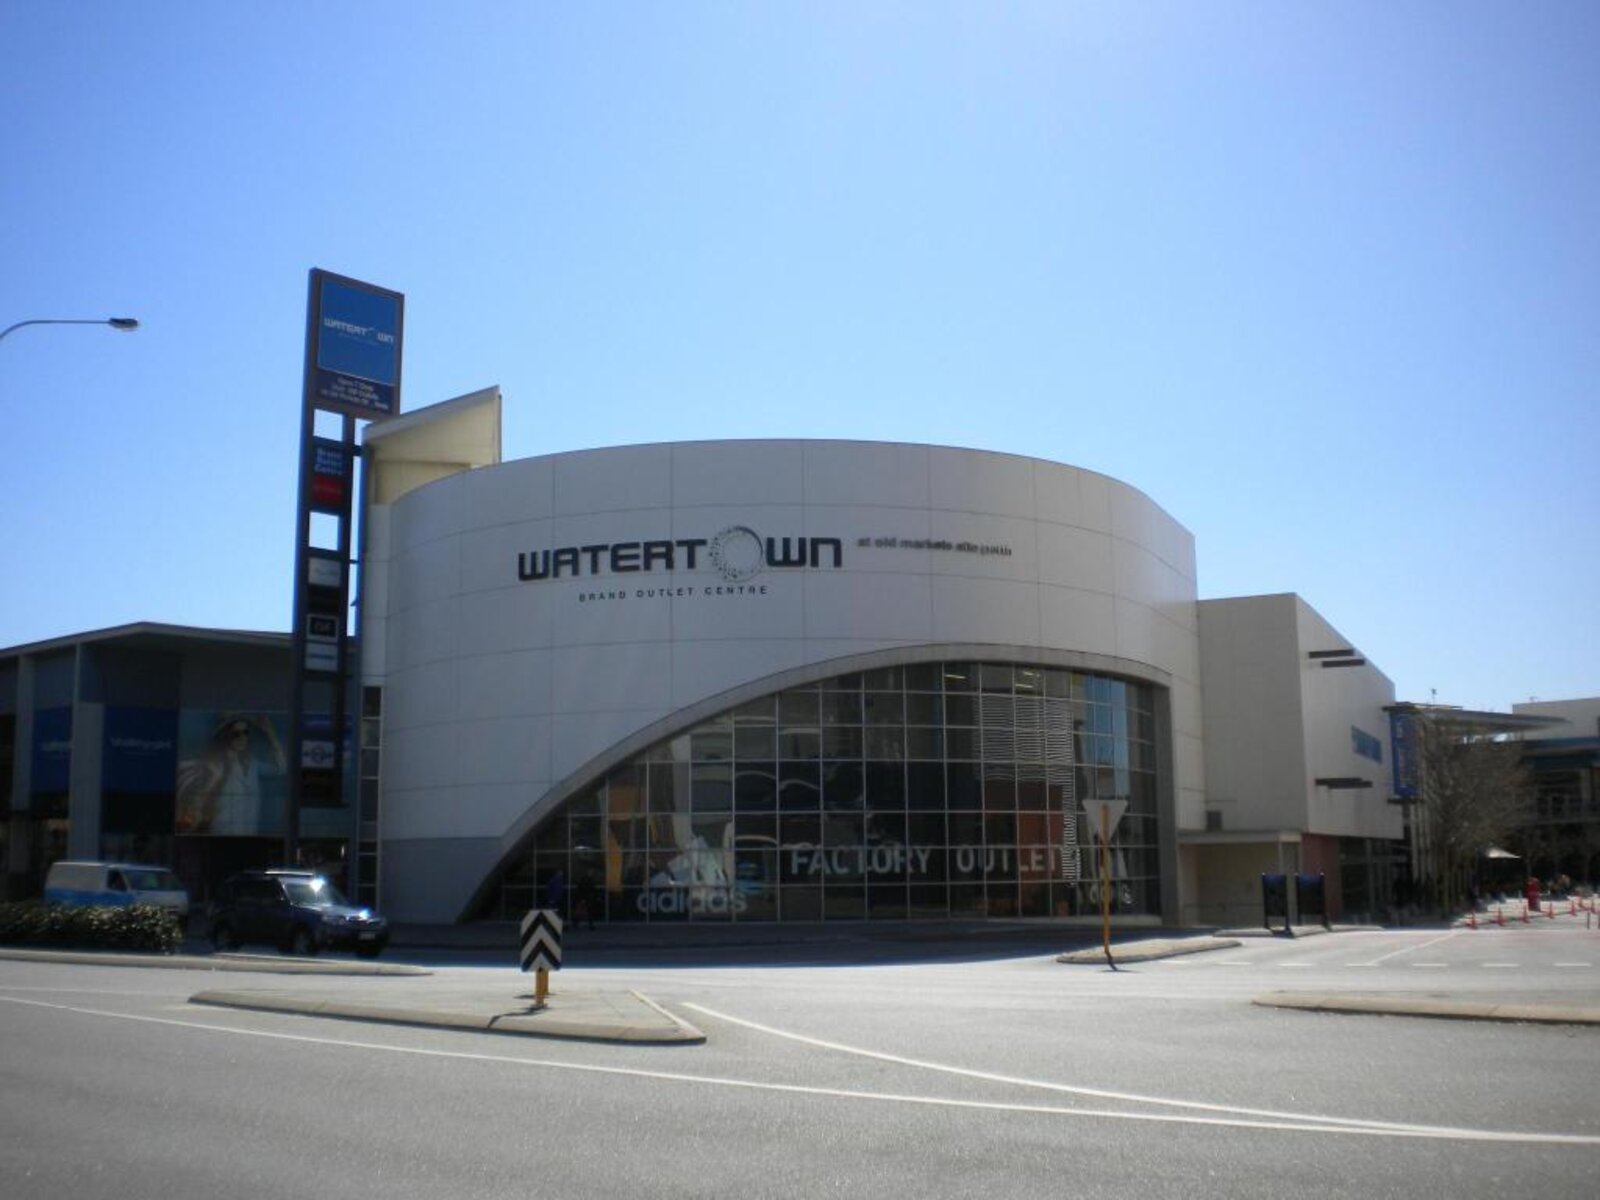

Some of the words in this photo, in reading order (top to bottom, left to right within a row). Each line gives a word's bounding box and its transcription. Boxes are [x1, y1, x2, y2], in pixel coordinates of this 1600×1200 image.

[323, 318, 394, 343] WATERTWN
[518, 526, 842, 581] WATERTOWN
[579, 591, 626, 602] BRAND
[637, 588, 693, 598] OUTLET
[704, 585, 767, 595] CENTRE
[791, 844, 930, 875] FACTORY
[956, 844, 1062, 873] OUTLET
[636, 886, 748, 912] adidas
